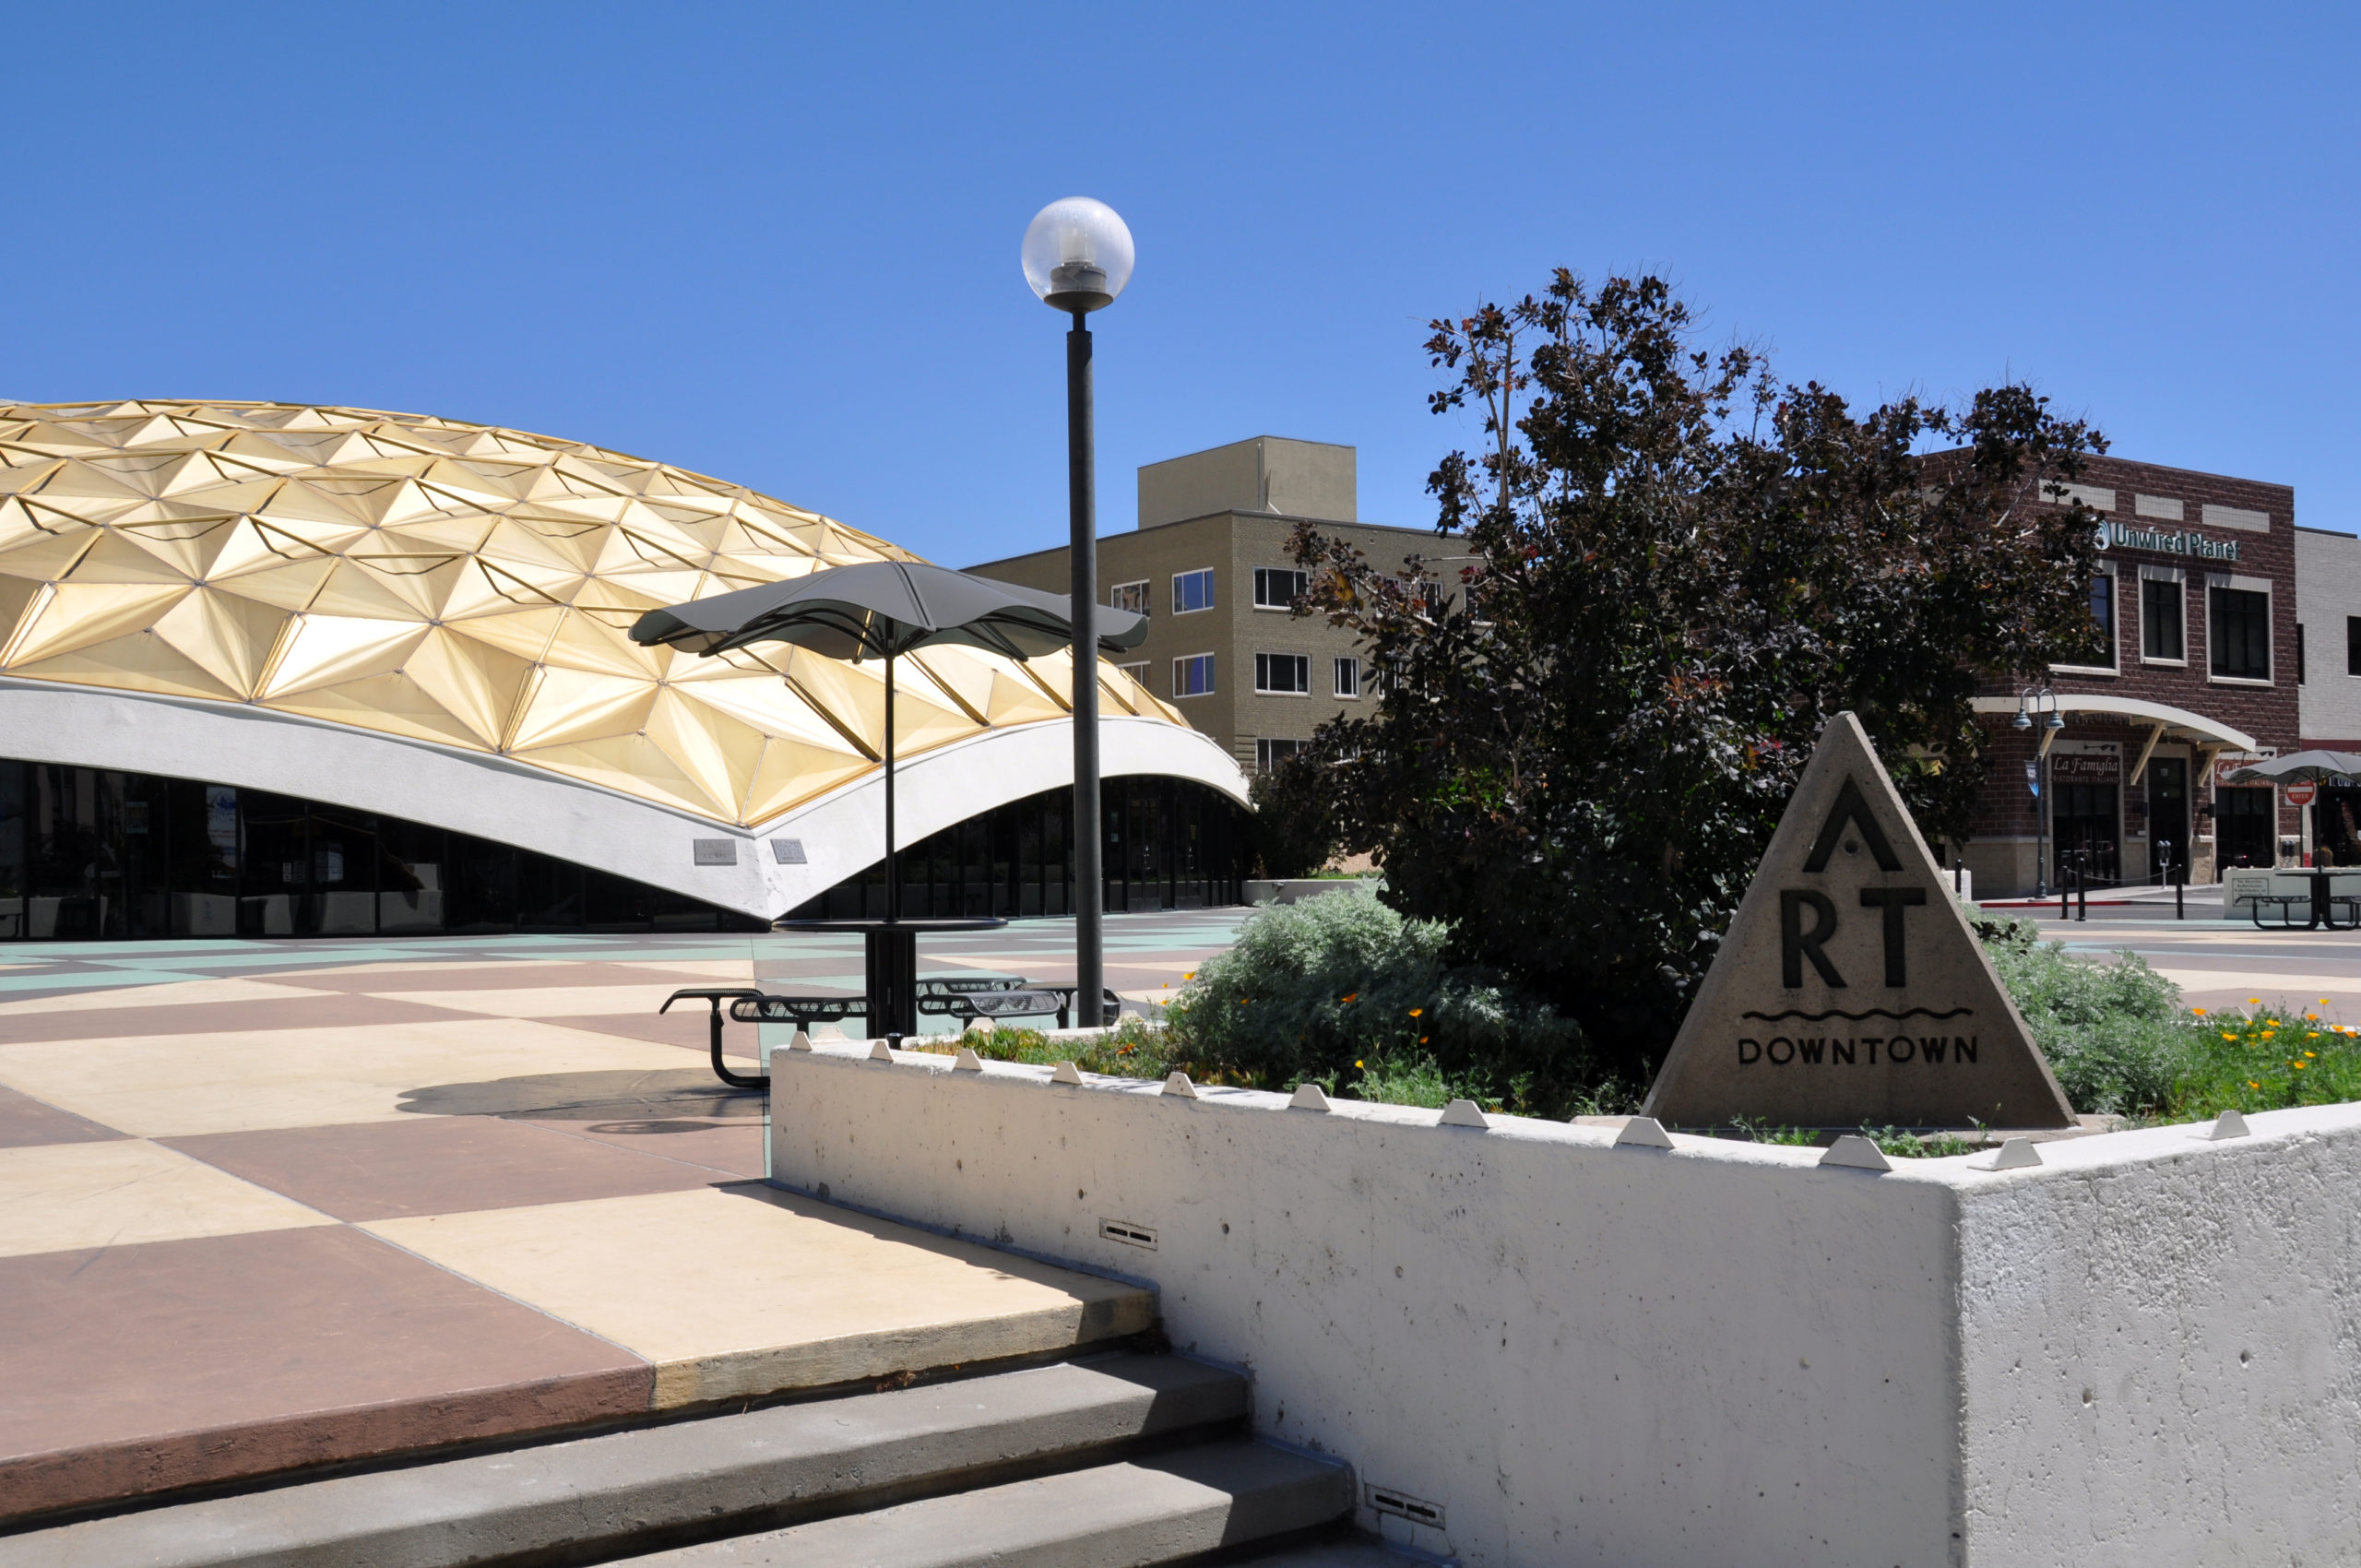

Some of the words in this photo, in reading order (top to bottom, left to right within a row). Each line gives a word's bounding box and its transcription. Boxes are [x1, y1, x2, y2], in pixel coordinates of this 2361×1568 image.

[2113, 523, 2185, 553] Unwired
[2187, 533, 2241, 561] Planet
[2054, 757, 2069, 770] La
[2070, 757, 2118, 776] Famiglia
[1738, 1036, 1978, 1065] DOWNTOWN
